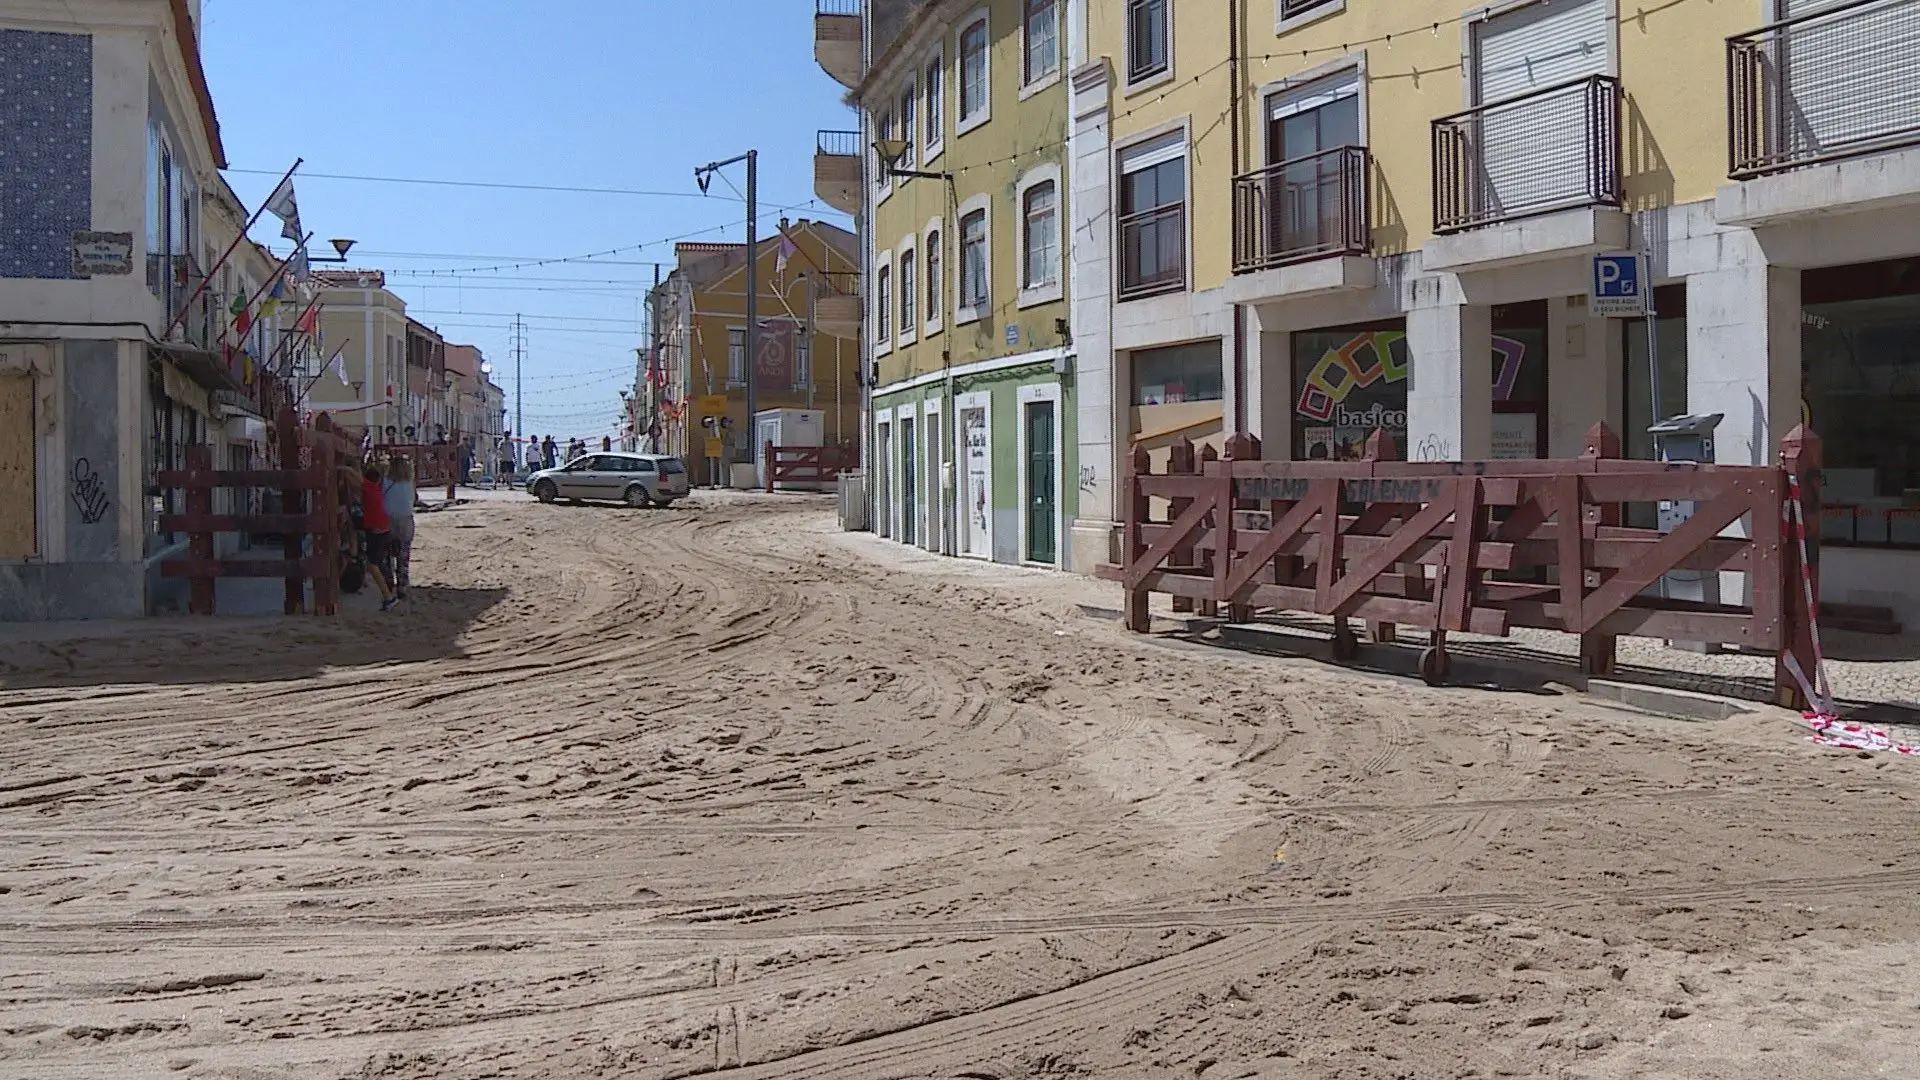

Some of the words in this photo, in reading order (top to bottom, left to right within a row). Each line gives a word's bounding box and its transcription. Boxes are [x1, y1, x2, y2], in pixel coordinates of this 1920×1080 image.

[1598, 260, 1620, 294] P
[1337, 402, 1407, 428] basico
[1703, 438, 1712, 458] P
